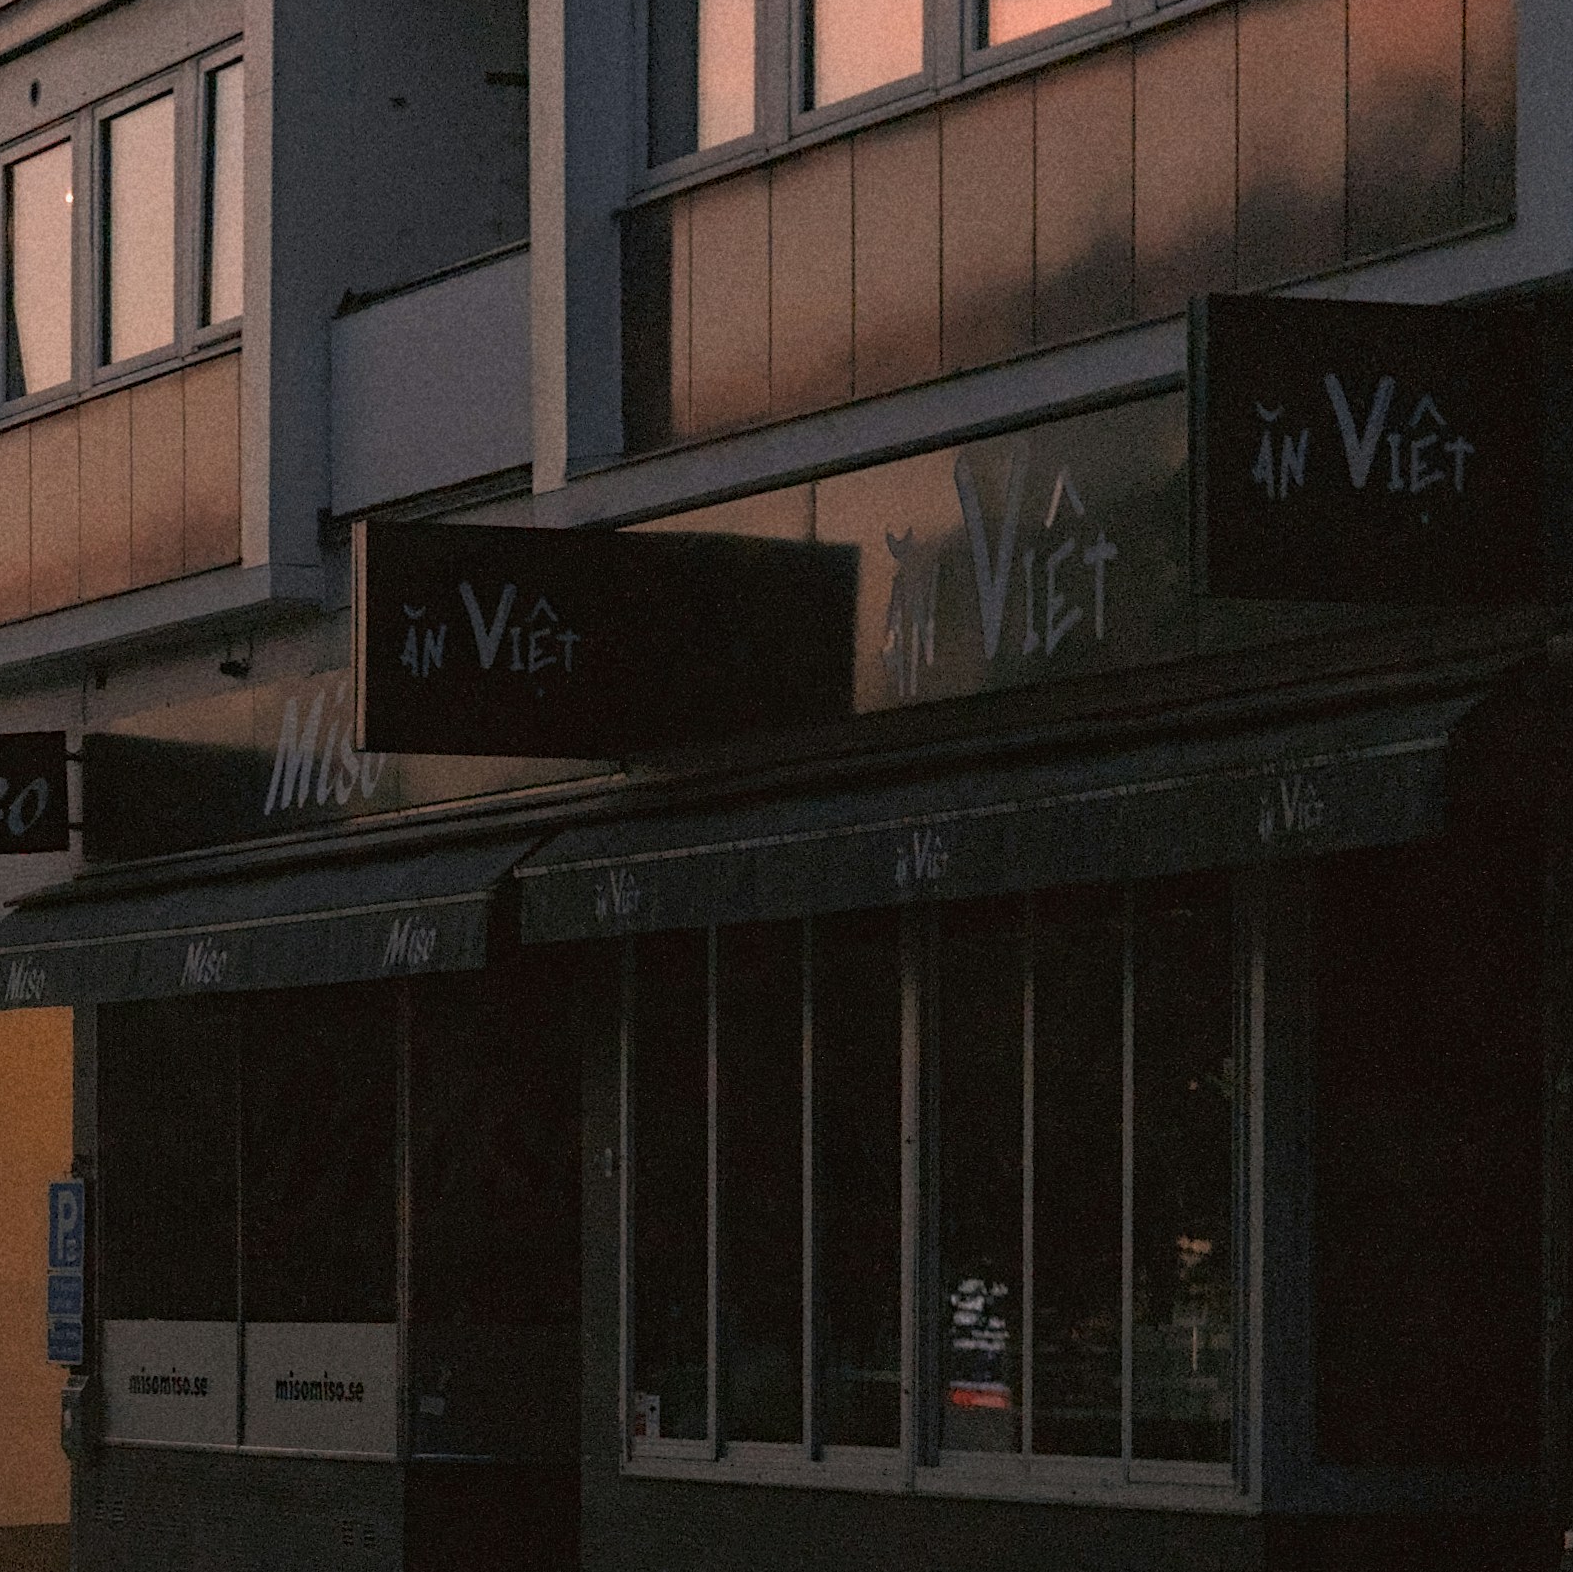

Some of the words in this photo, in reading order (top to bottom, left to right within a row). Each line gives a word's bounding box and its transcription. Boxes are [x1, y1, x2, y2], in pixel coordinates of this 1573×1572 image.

[180, 937, 228, 987] Miso
[381, 915, 437, 968] Miso
[4, 955, 46, 1002] Miso
[57, 1190, 78, 1261] P
[129, 1366, 208, 1397] misomiso.se
[275, 1370, 364, 1401] misomiso.se
